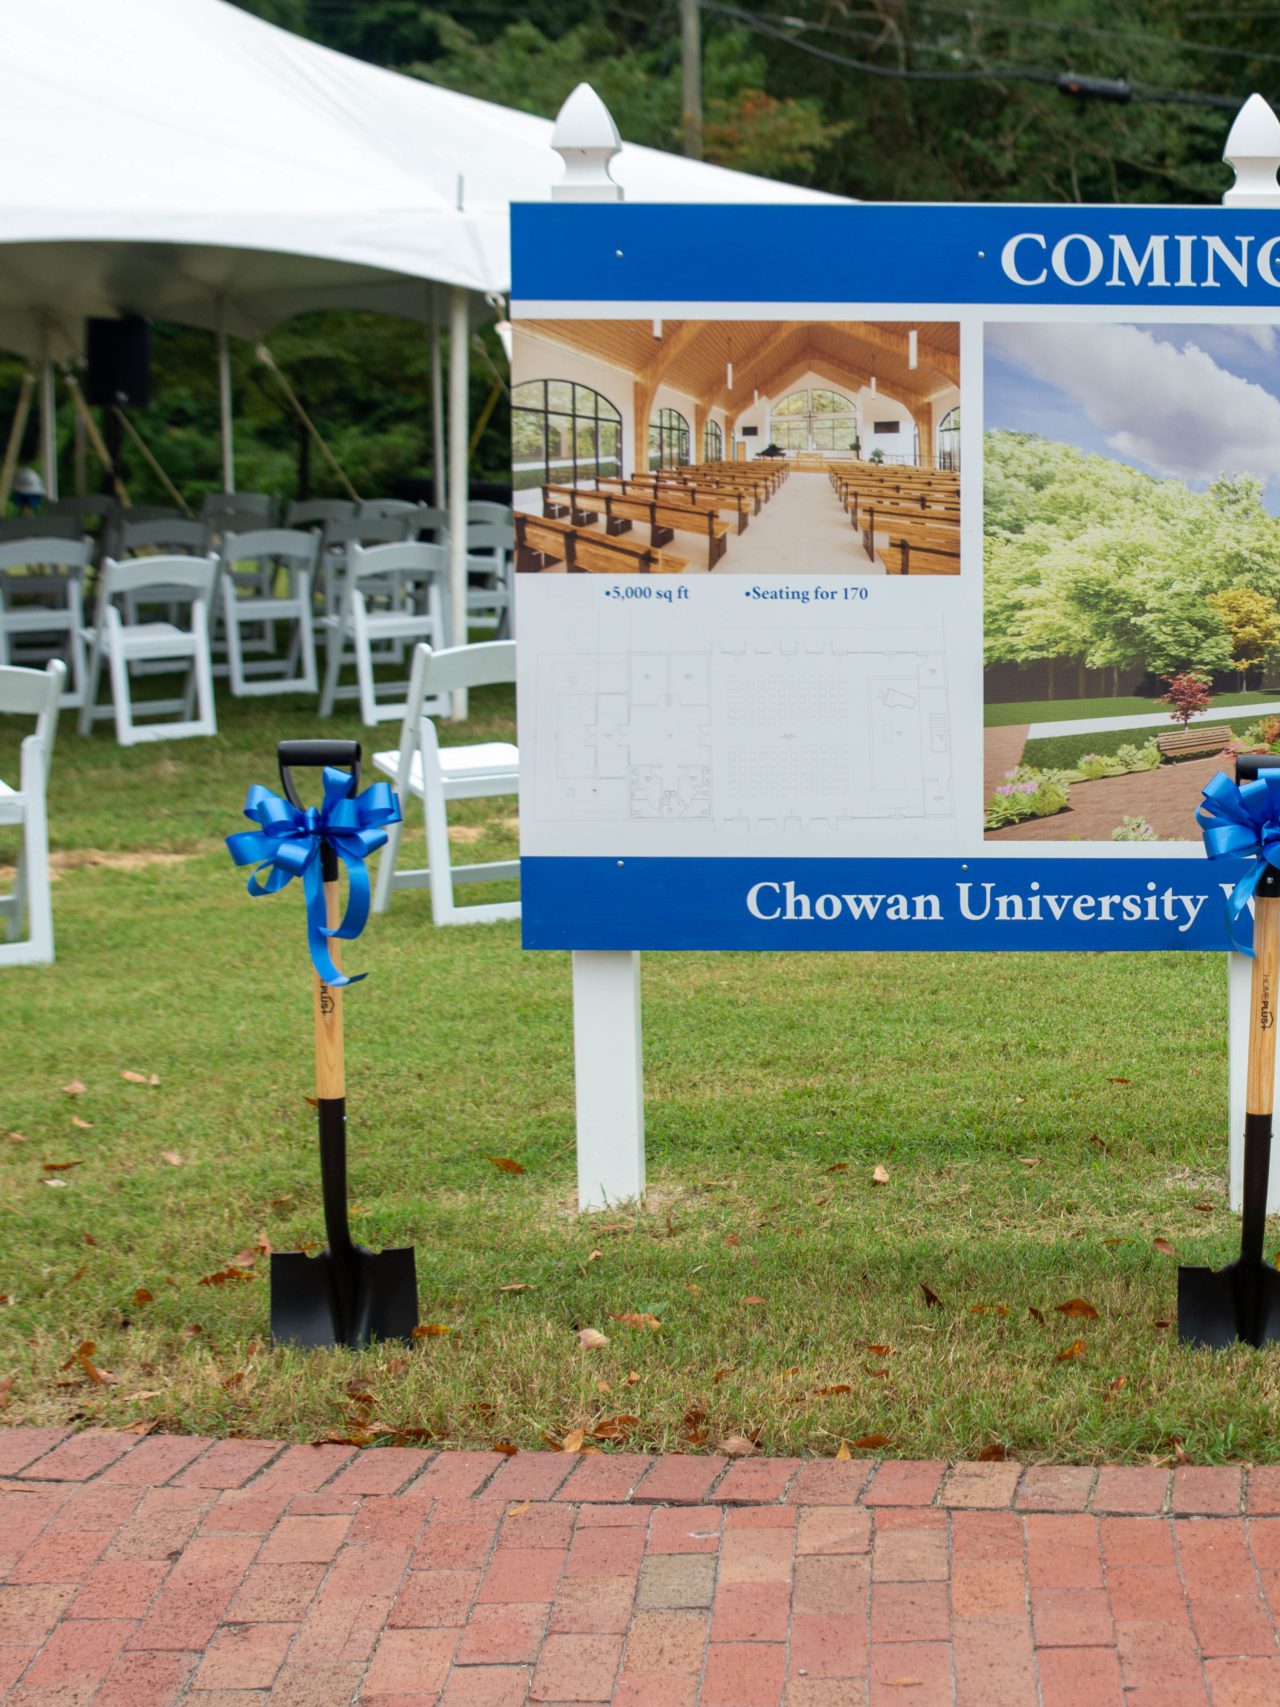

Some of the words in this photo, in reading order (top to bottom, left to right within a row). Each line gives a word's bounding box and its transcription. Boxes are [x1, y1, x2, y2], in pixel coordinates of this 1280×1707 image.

[656, 589, 673, 602] sq
[677, 586, 689, 600] ft
[814, 587, 838, 600] for
[844, 588, 869, 600] 170
[746, 881, 944, 921] Chowan
[956, 882, 1208, 932] University
